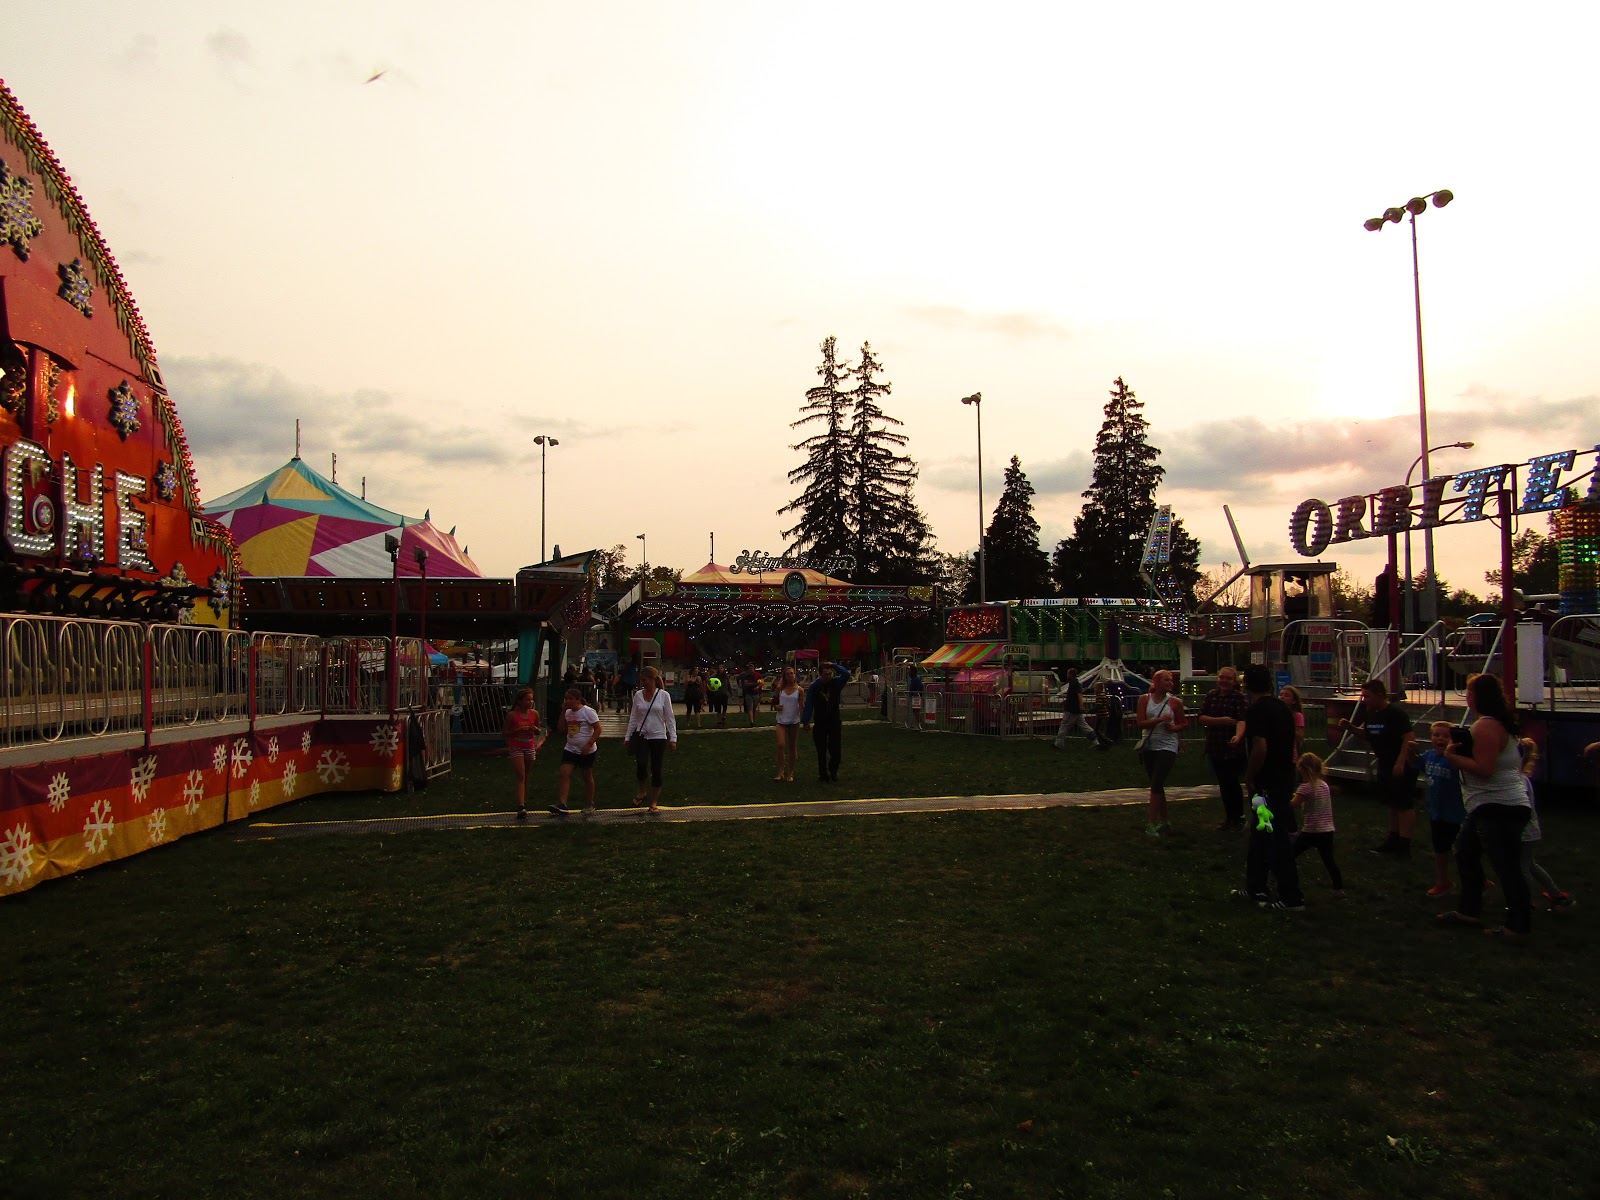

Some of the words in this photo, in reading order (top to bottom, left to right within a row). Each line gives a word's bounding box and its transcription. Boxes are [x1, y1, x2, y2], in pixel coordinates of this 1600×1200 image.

[1289, 445, 1600, 557] ORBITE
[1347, 635, 1363, 644] EXIT
[1009, 646, 1024, 654] EXIT
